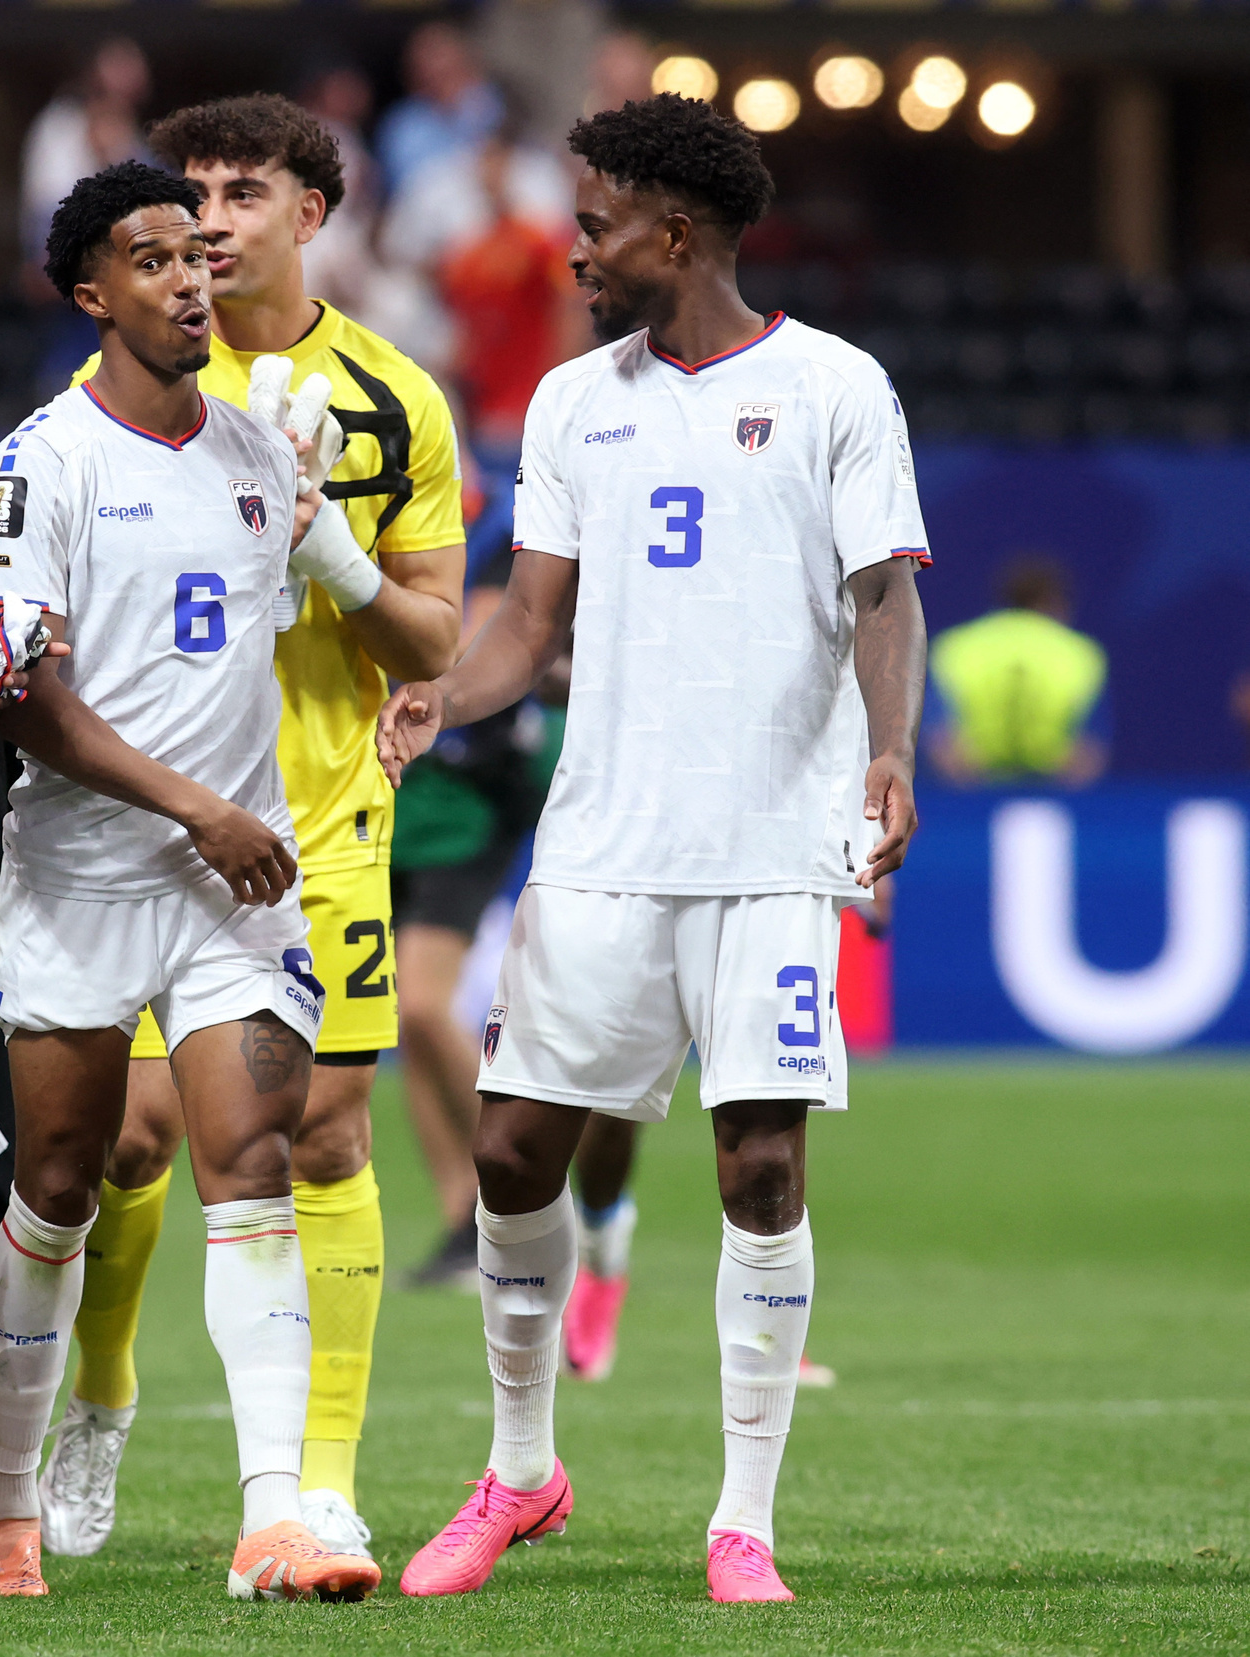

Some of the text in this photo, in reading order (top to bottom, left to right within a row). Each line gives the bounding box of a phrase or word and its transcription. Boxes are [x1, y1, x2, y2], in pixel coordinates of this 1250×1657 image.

[739, 405, 776, 414] FCF
[584, 424, 638, 445] capelli
[605, 437, 634, 446] SPORT
[232, 482, 259, 492] FCF
[98, 502, 154, 521] capelli
[648, 486, 704, 568] 3
[174, 572, 228, 653] 6
[989, 798, 1248, 1054] U
[344, 915, 399, 999] 2
[285, 985, 321, 1024] capelli
[776, 965, 821, 1048] 3
[743, 1293, 808, 1308] capelli
